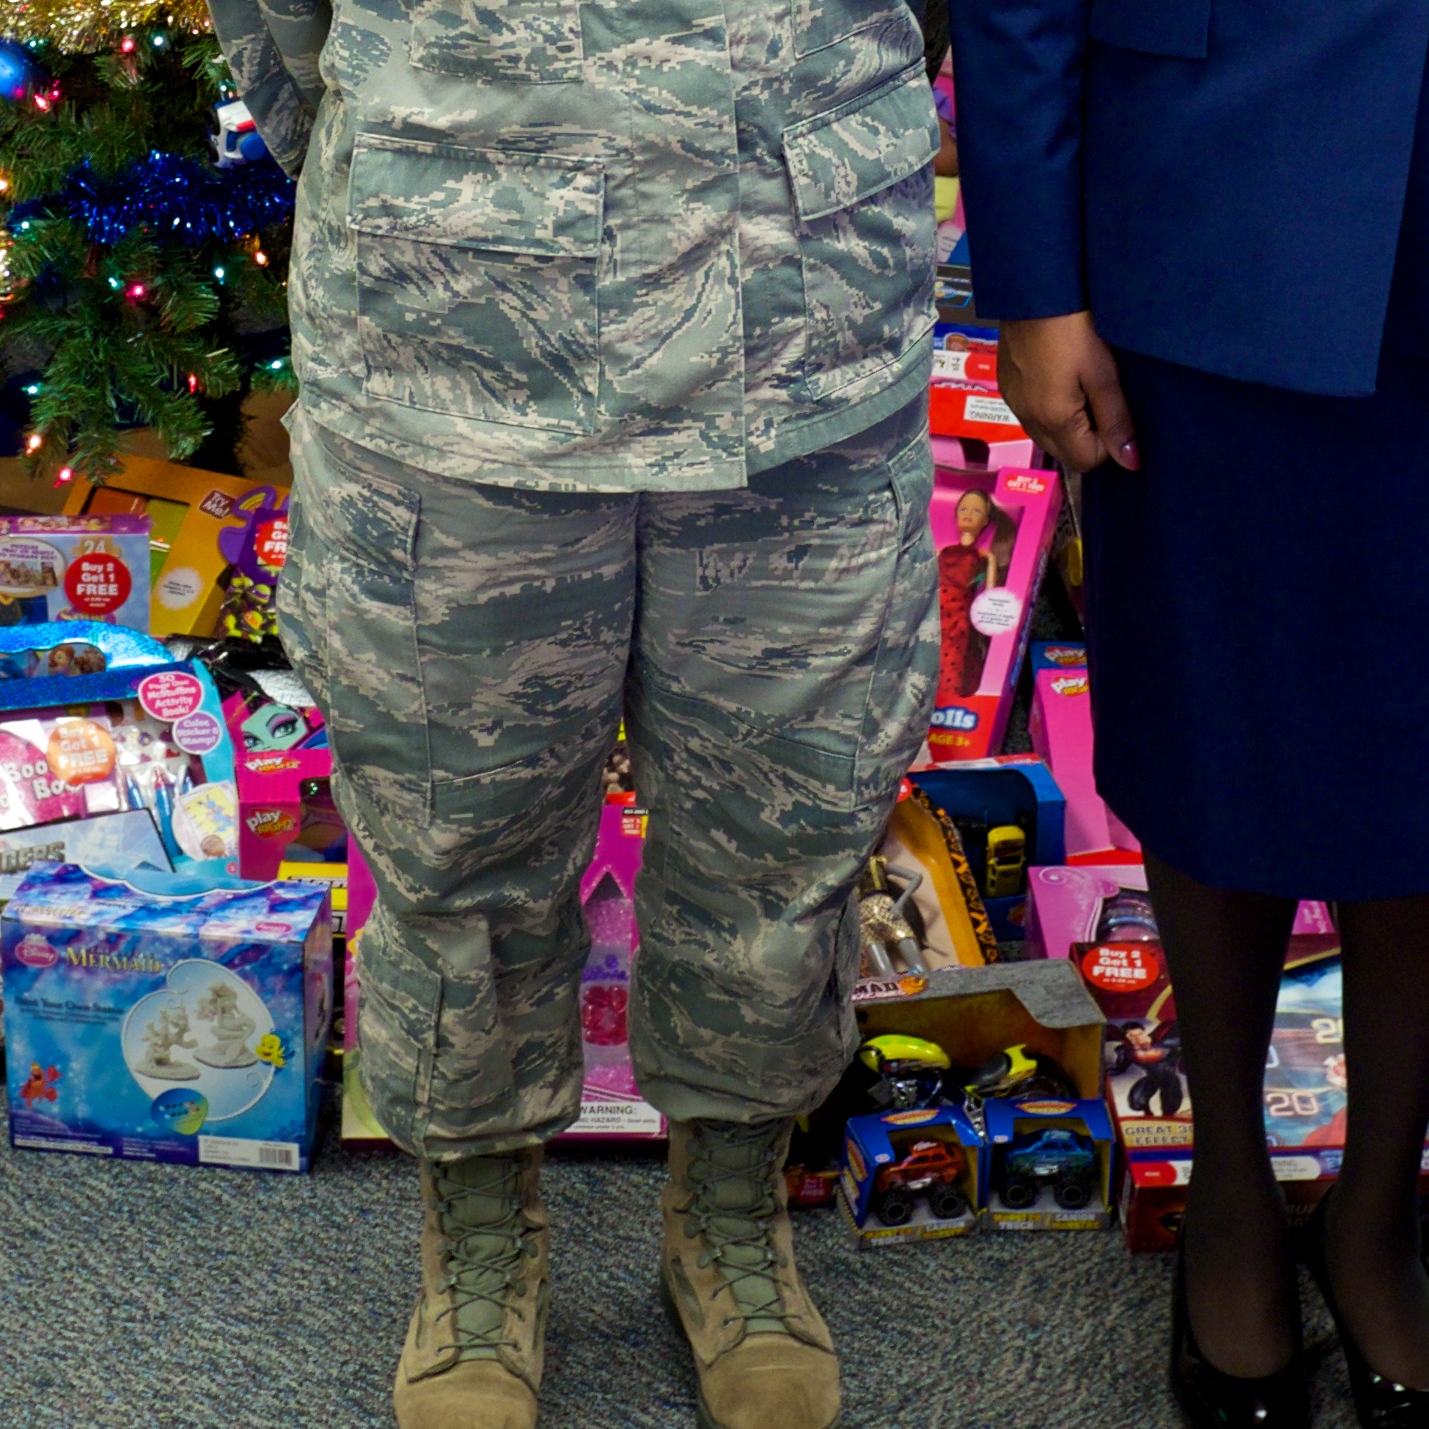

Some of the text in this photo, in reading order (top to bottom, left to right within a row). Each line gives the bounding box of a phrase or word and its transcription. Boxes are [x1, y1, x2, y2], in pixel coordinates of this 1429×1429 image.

[211, 490, 231, 505] Try
[202, 499, 232, 517] Me!
[263, 541, 287, 553] FR
[81, 561, 114, 573] Buy 2
[81, 572, 105, 583] Get
[76, 584, 119, 597] FREE
[1051, 677, 1086, 694] play
[930, 708, 977, 728] olls
[928, 733, 971, 747] AGE 3+
[58, 748, 110, 771] FREE
[245, 758, 283, 770] play
[246, 809, 282, 832] play
[65, 946, 163, 974] MERMAID
[1098, 948, 1142, 959] Buy 2
[1098, 958, 1129, 968] Get
[1091, 966, 1148, 980] FREE
[1266, 1091, 1319, 1117] 20
[1125, 1125, 1172, 1137] GREAT
